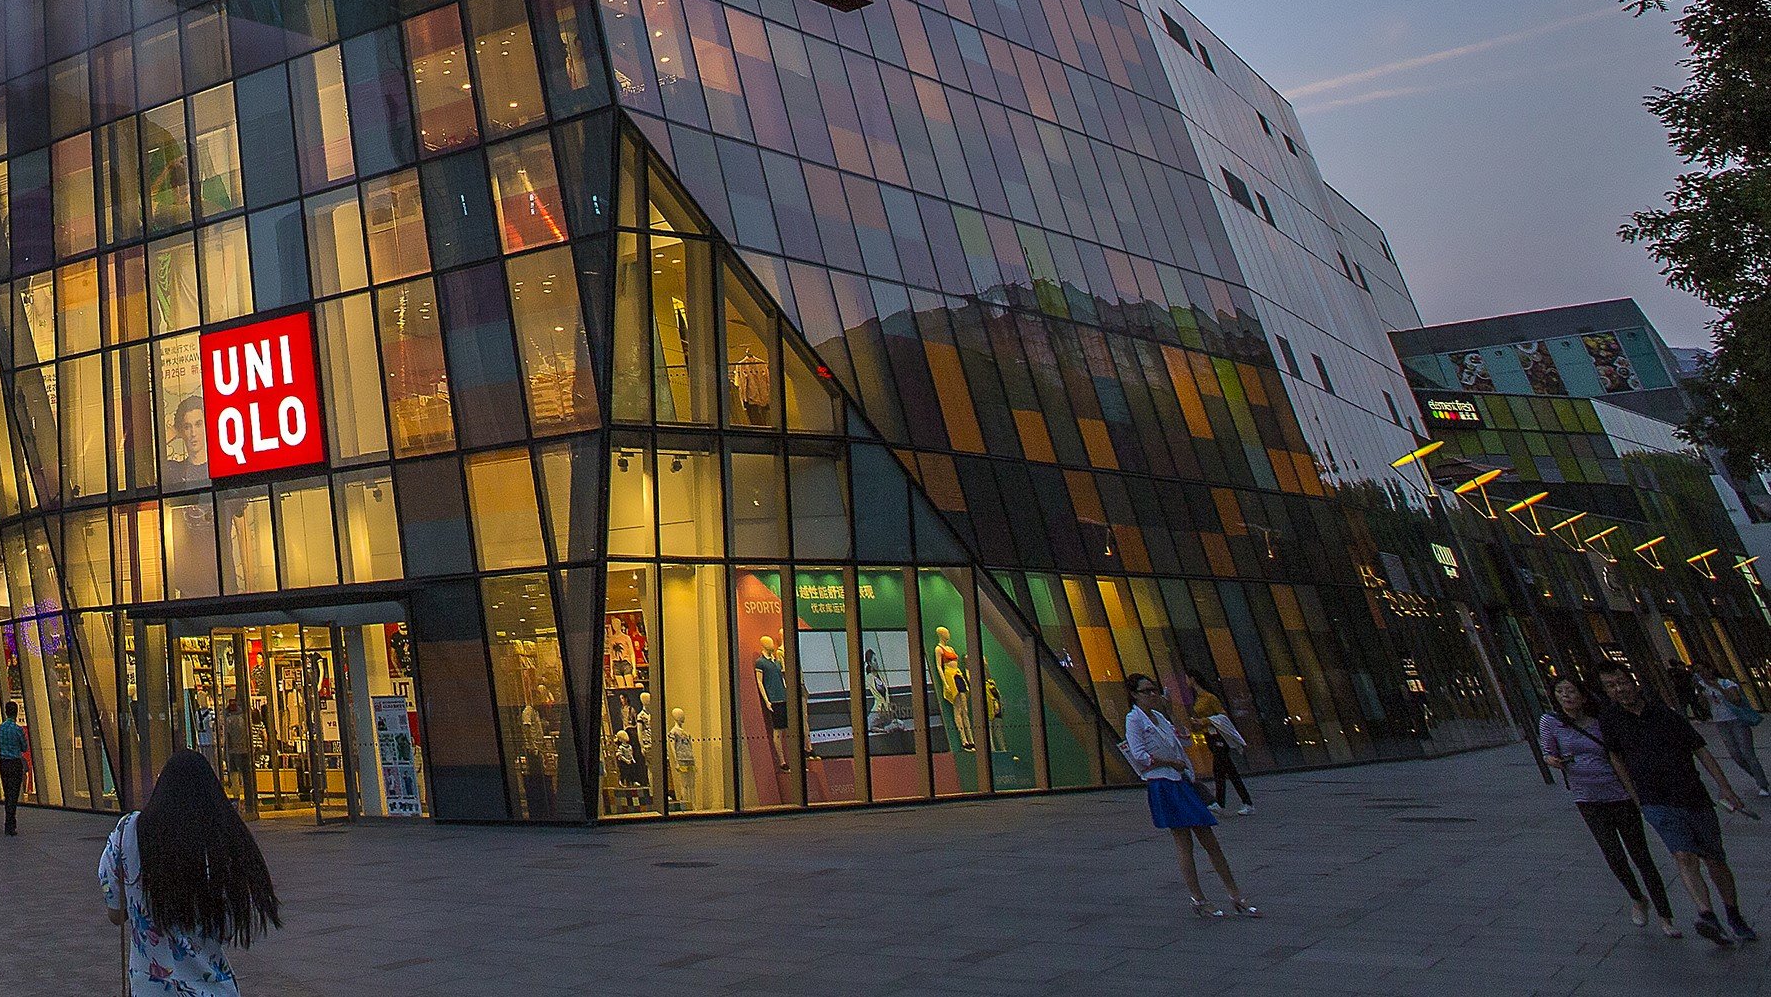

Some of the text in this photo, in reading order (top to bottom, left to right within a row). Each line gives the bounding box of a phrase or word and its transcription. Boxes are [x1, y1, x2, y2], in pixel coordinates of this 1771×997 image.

[211, 334, 295, 397] UNI
[217, 395, 308, 465] QLO
[744, 600, 781, 615] SPORTS
